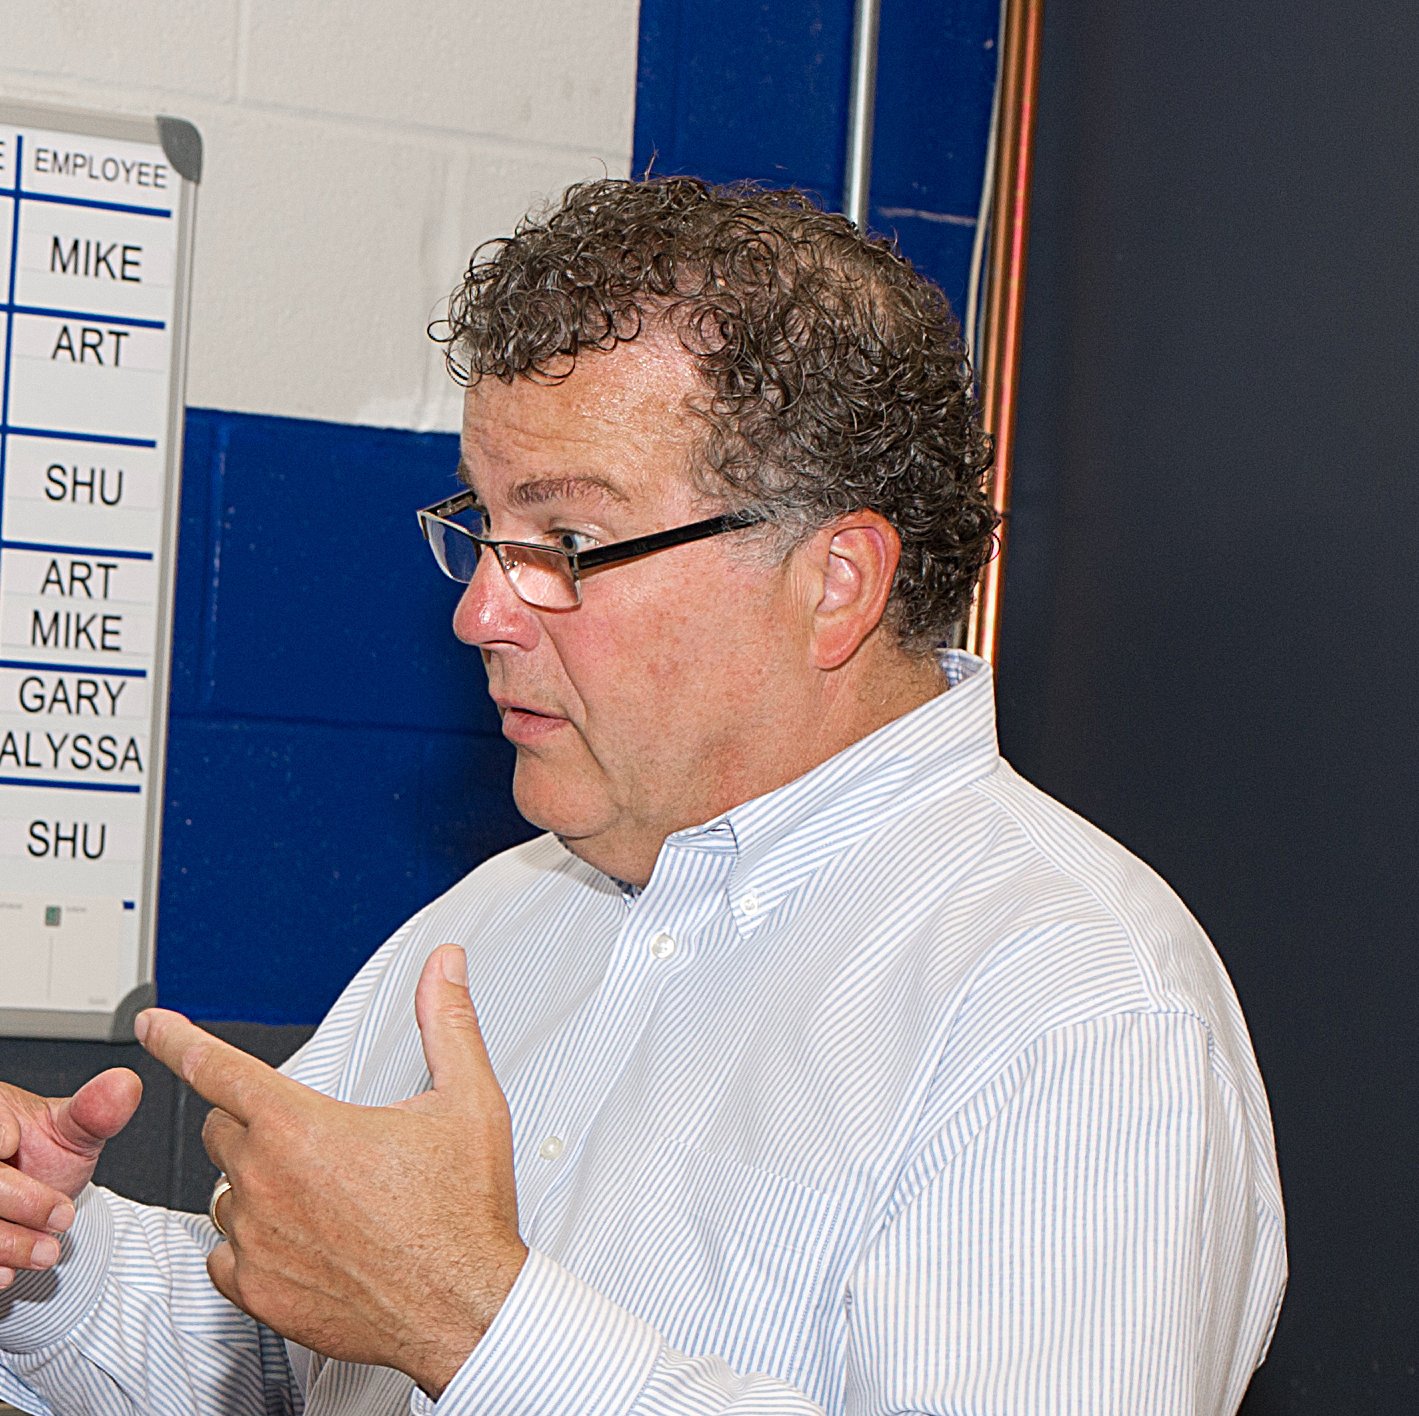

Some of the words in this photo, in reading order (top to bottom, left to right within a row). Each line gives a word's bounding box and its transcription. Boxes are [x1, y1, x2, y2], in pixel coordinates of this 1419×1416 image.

[34, 148, 168, 189] EMPLOYEE
[49, 236, 143, 284] MIKE
[51, 325, 129, 368] ART
[44, 464, 124, 506] SHU
[40, 559, 118, 601] ART
[30, 610, 122, 652] MIKE
[18, 675, 127, 717] GARY
[26, 820, 106, 860] SHU
